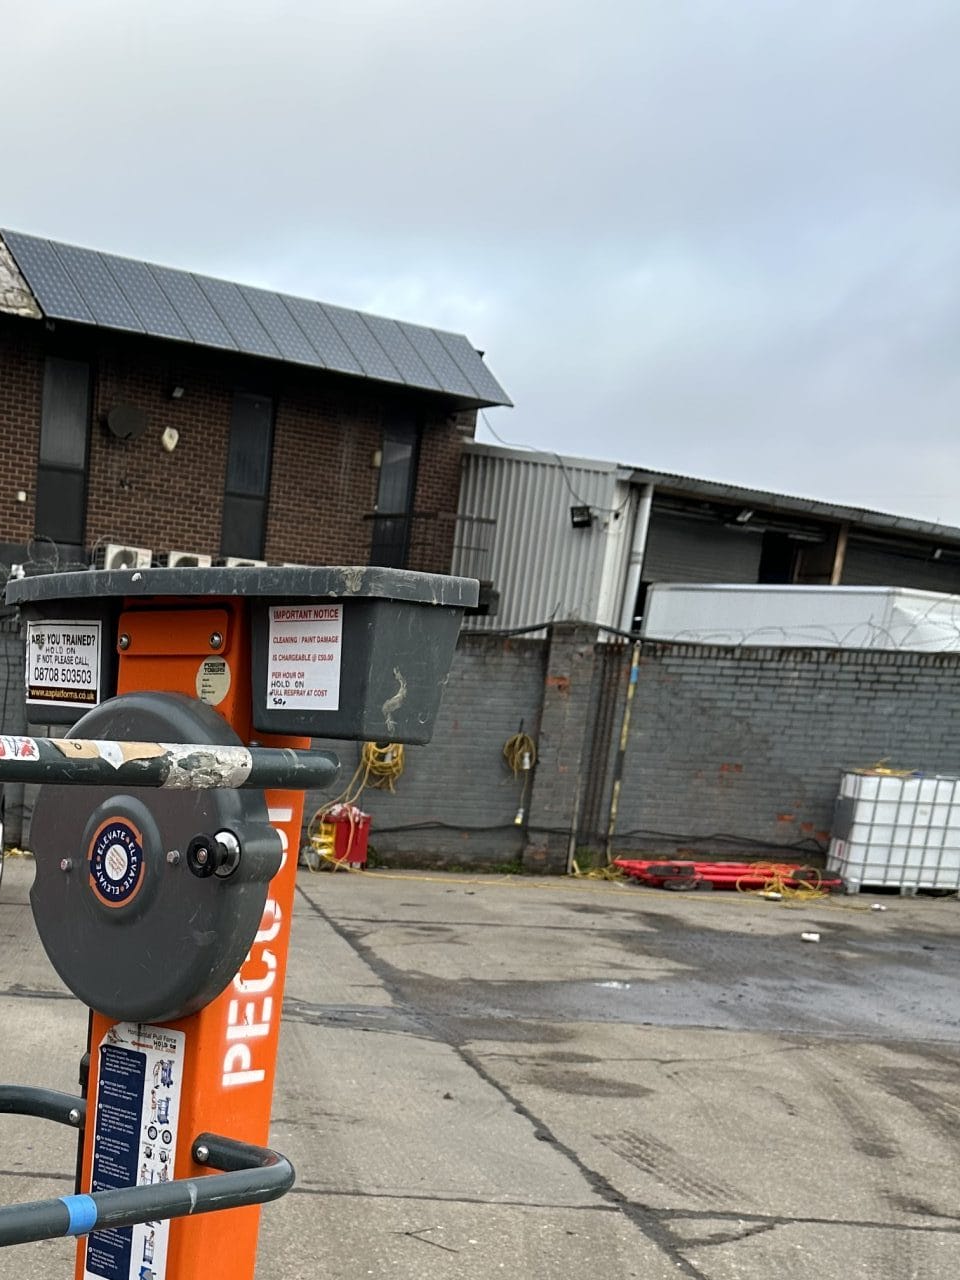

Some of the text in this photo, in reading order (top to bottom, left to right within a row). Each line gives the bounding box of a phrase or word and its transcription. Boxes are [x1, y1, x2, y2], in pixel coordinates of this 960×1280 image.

[273, 608, 339, 620] IMPORTANT NOTICE
[31, 633, 96, 646] ARE YOU TRAINED?
[273, 636, 298, 644] CLEANING
[317, 635, 339, 643] DAMAGE
[45, 646, 76, 655] HOLD ON
[55, 655, 74, 665] PLEASE
[34, 667, 92, 684] 08708 503503
[271, 671, 305, 679] PER HOUR OR
[270, 680, 305, 688] HOLD ON
[283, 689, 306, 697] RESPRAY
[306, 689, 313, 697] AT
[314, 689, 328, 697] COST
[97, 829, 127, 855] ELEVATE
[123, 841, 138, 890] ELEVATE
[95, 863, 120, 895] ELEVATE
